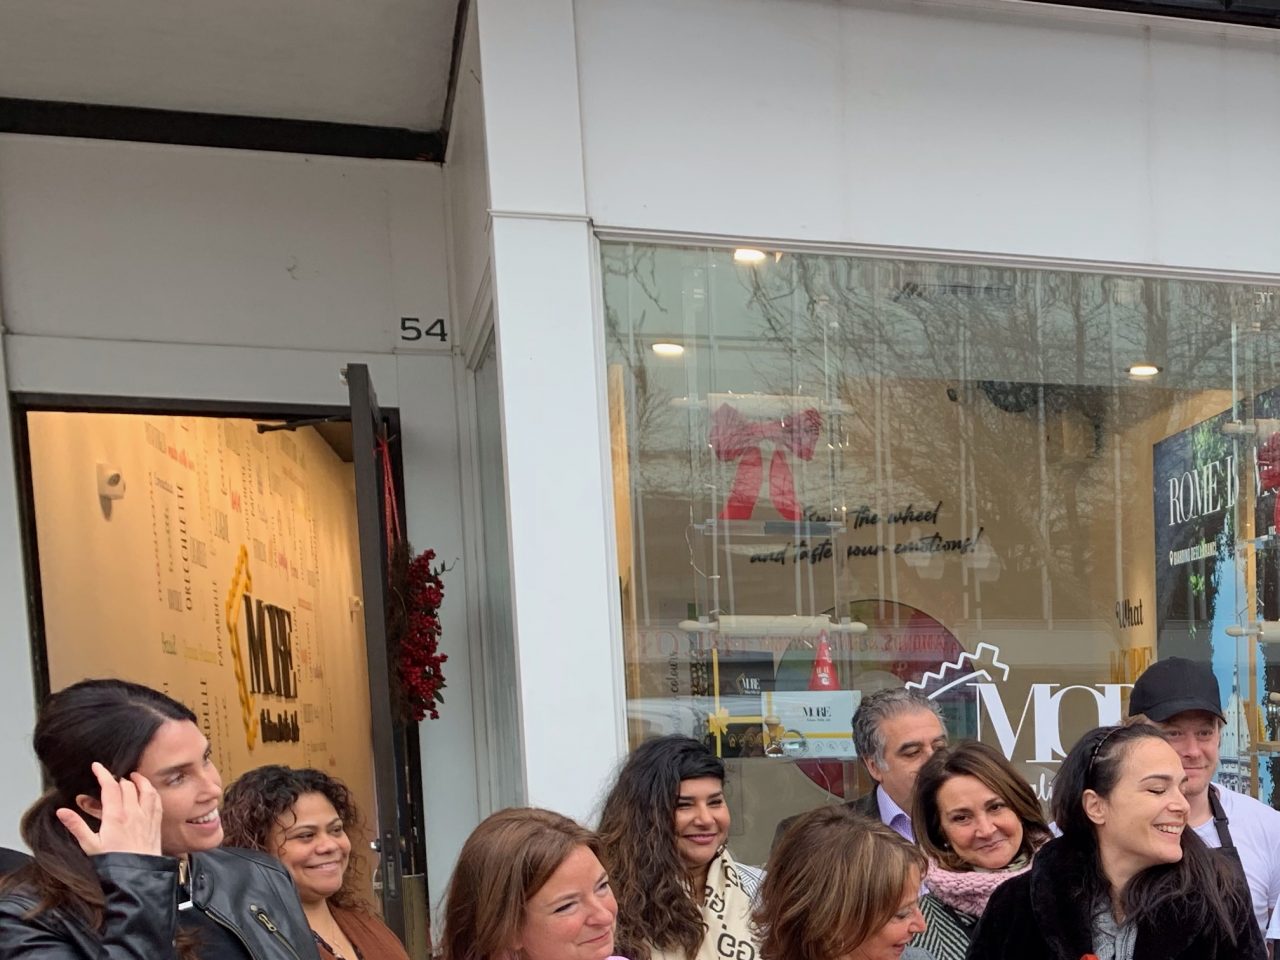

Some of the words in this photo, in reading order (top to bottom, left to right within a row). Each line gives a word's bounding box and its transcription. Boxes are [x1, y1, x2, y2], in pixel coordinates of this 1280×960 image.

[401, 317, 448, 341] 54
[1168, 461, 1221, 526] ROME
[888, 501, 943, 525] wheel
[750, 542, 790, 565] and
[793, 538, 833, 565] taste
[1115, 598, 1143, 628] What
